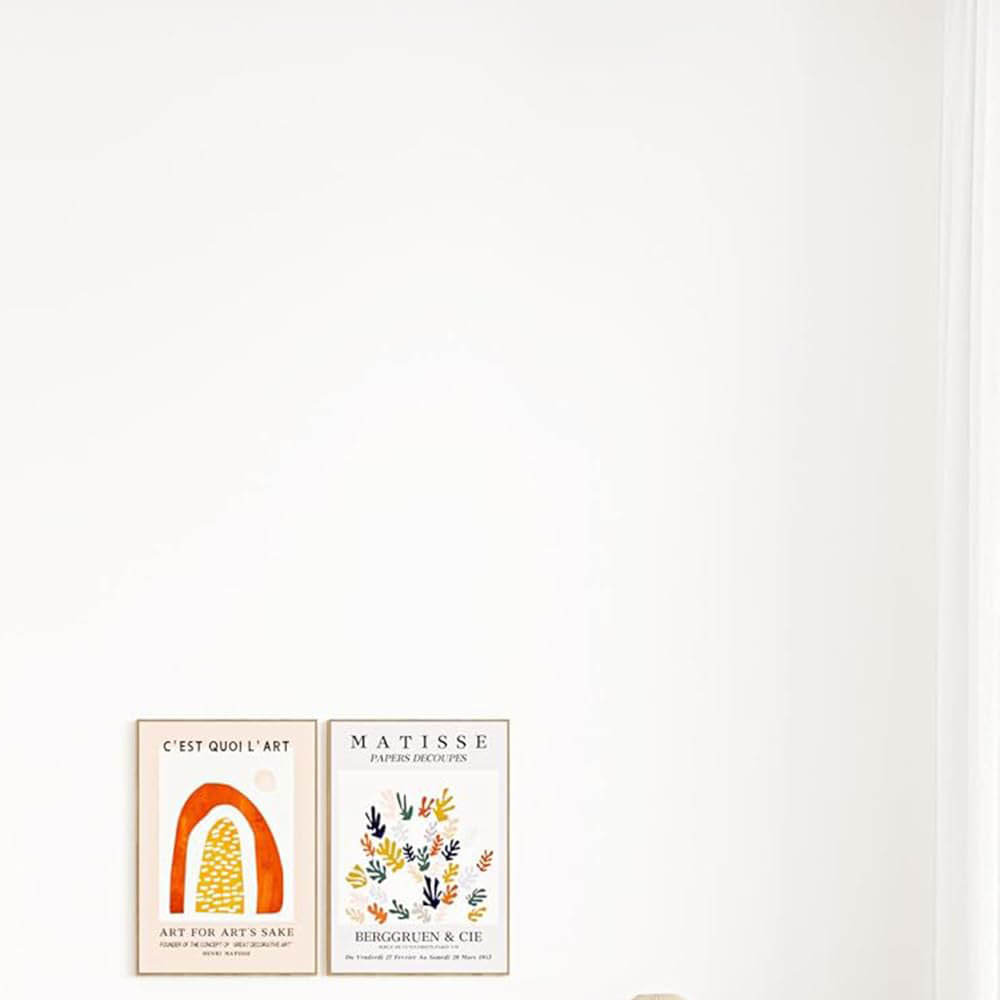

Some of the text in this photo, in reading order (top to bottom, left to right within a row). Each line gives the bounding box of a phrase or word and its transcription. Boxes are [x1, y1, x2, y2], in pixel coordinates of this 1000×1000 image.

[163, 740, 203, 753] C'EST
[208, 740, 243, 753] QUOI
[350, 735, 487, 749] MATISSE
[370, 754, 467, 763] PAPERS DECOUPES
[159, 927, 294, 937] ART FOR ART'S SAKE
[355, 931, 483, 943] BERGGRUEN & CIE
